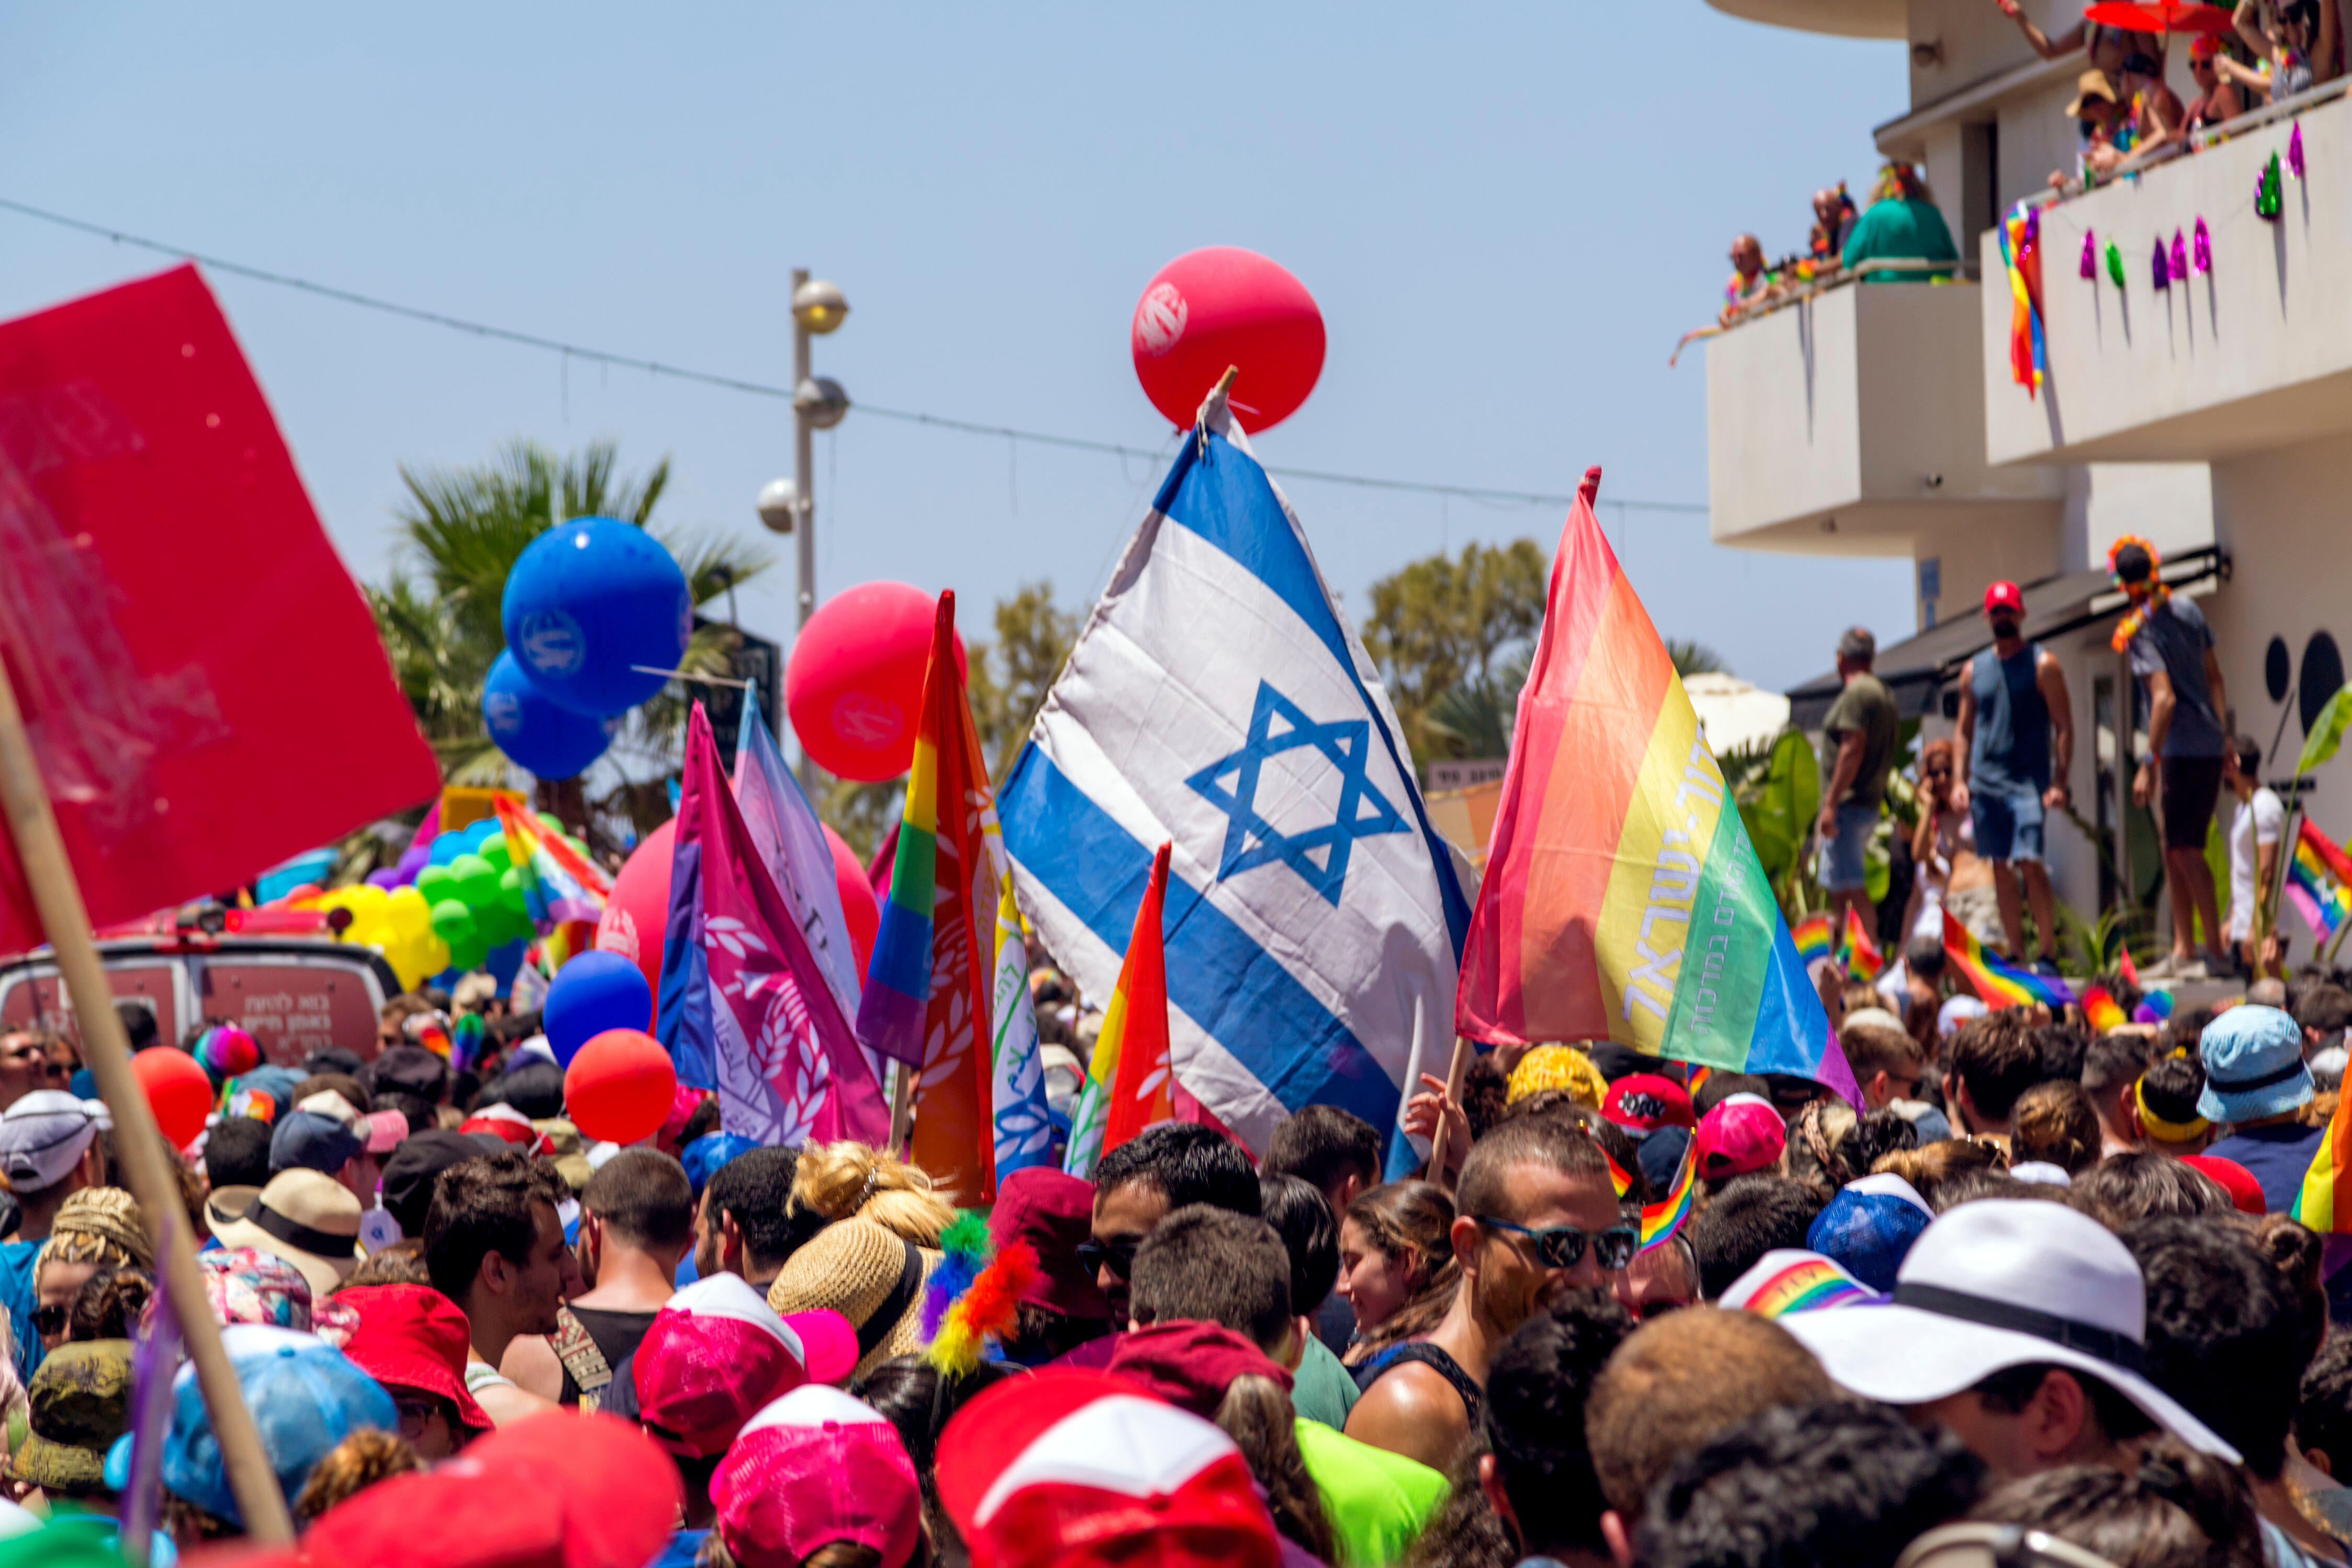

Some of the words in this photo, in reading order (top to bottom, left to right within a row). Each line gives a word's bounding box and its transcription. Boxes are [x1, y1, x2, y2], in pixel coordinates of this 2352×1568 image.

[1713, 859, 1748, 927] האדם
[298, 993, 330, 1011] בוא
[1690, 933, 1729, 1034] במרכזה
